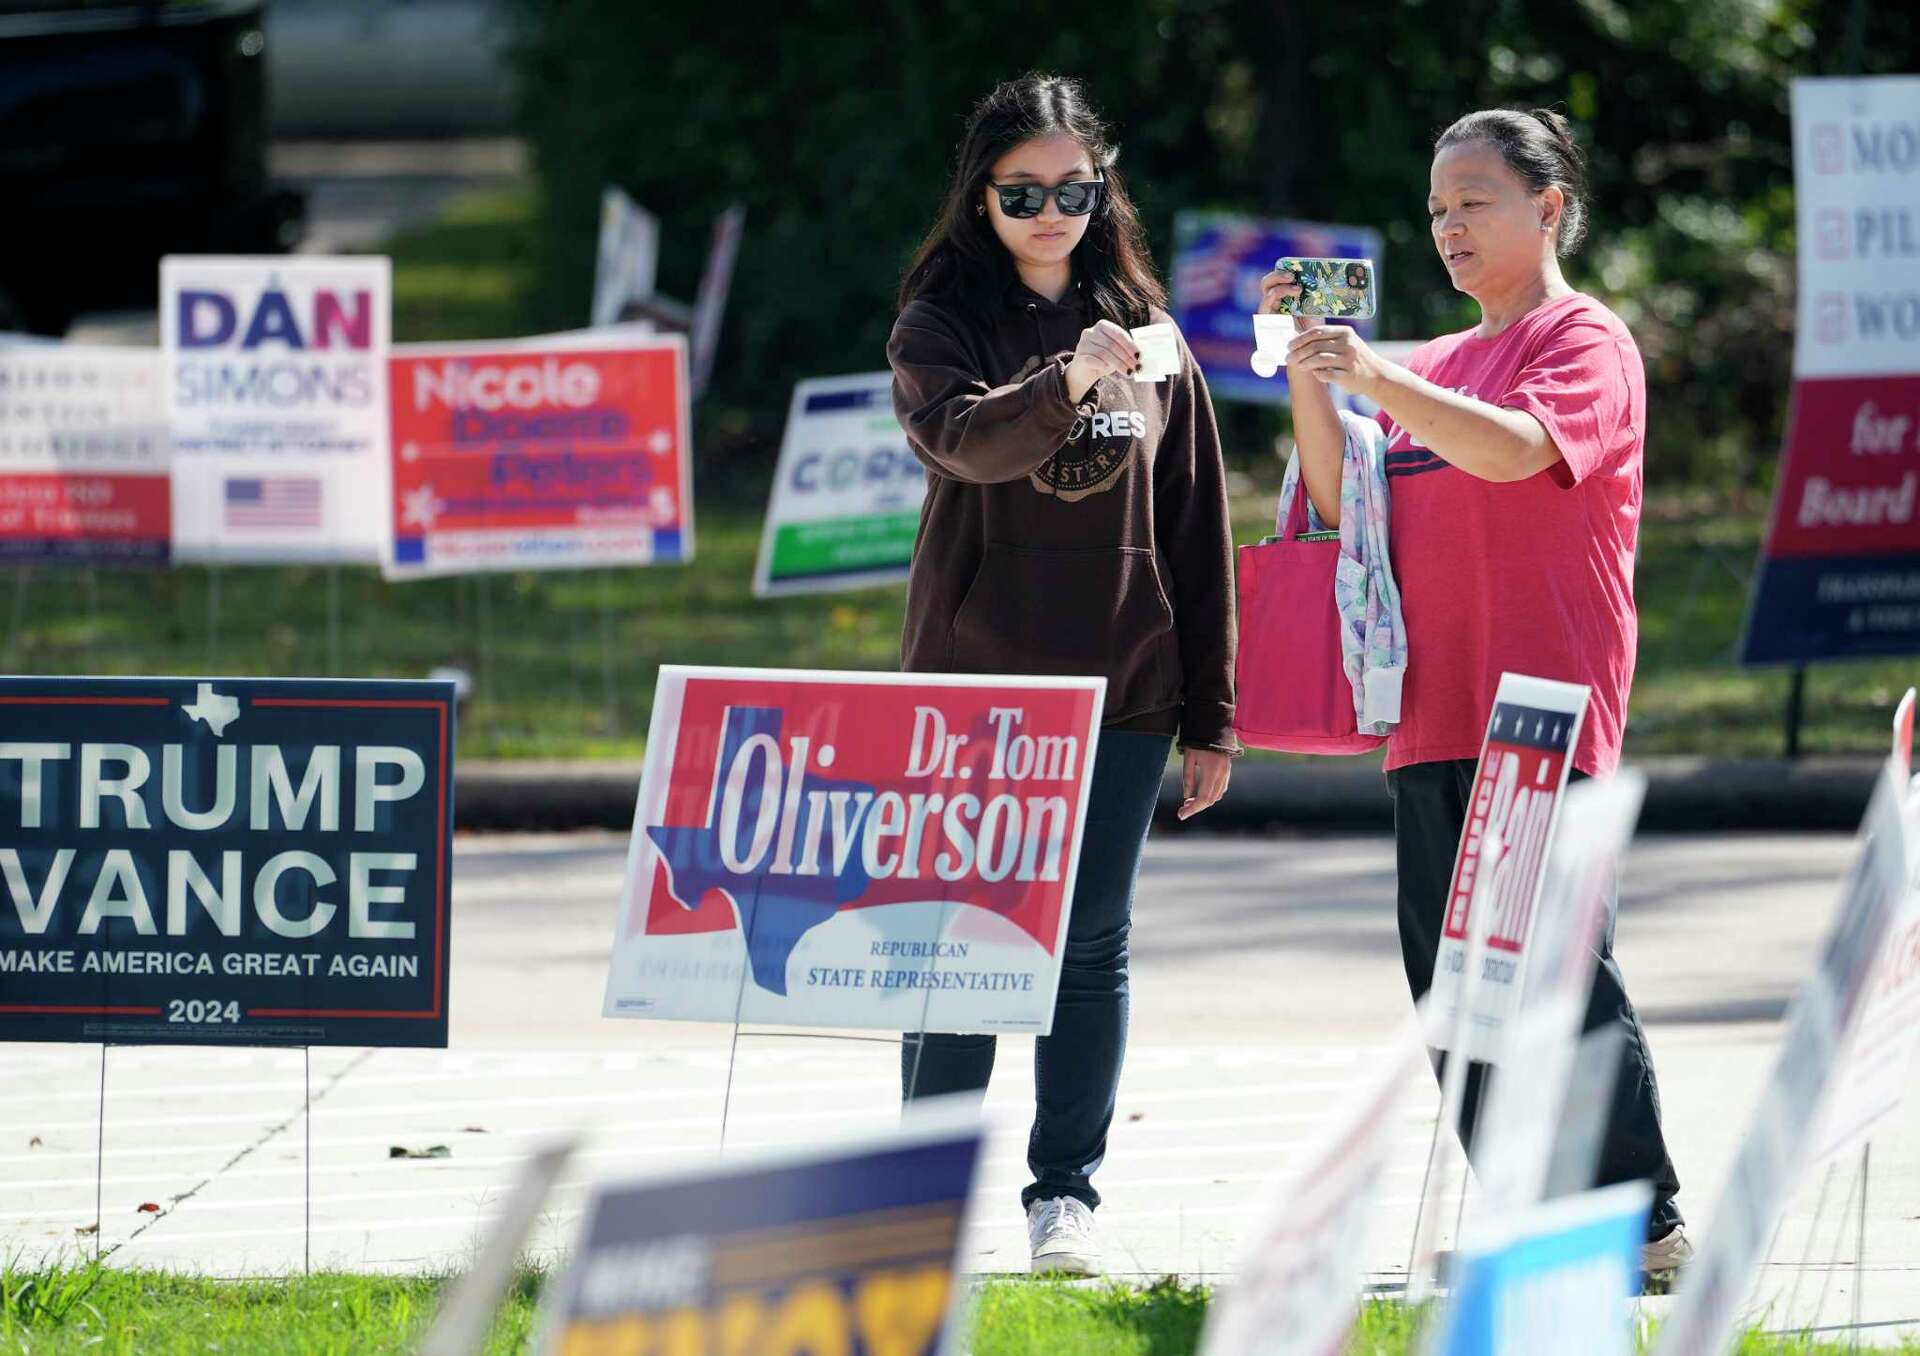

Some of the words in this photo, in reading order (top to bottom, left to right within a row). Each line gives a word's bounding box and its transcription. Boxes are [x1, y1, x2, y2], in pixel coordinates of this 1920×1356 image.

[177, 290, 372, 350] DAN
[176, 363, 371, 408] SIMONS
[413, 358, 601, 412] Nicole
[1852, 400, 1909, 455] for
[1045, 455, 1111, 483] ESTER
[1798, 471, 1916, 527] Board
[904, 705, 973, 780] Dr.
[988, 706, 1078, 782] Tom
[0, 743, 426, 832] TRUMP
[718, 733, 1067, 884] Oliverson
[0, 848, 418, 939] VANCE
[0, 951, 75, 973] MAKE
[82, 951, 215, 975] AMERICA
[222, 952, 321, 977] GREAT
[328, 954, 419, 978] AGAIN
[869, 940, 969, 958] REPUBLICAN
[807, 967, 865, 988] STATE
[870, 970, 1035, 991] REPRESENTATIVE
[168, 999, 241, 1023] 2024
